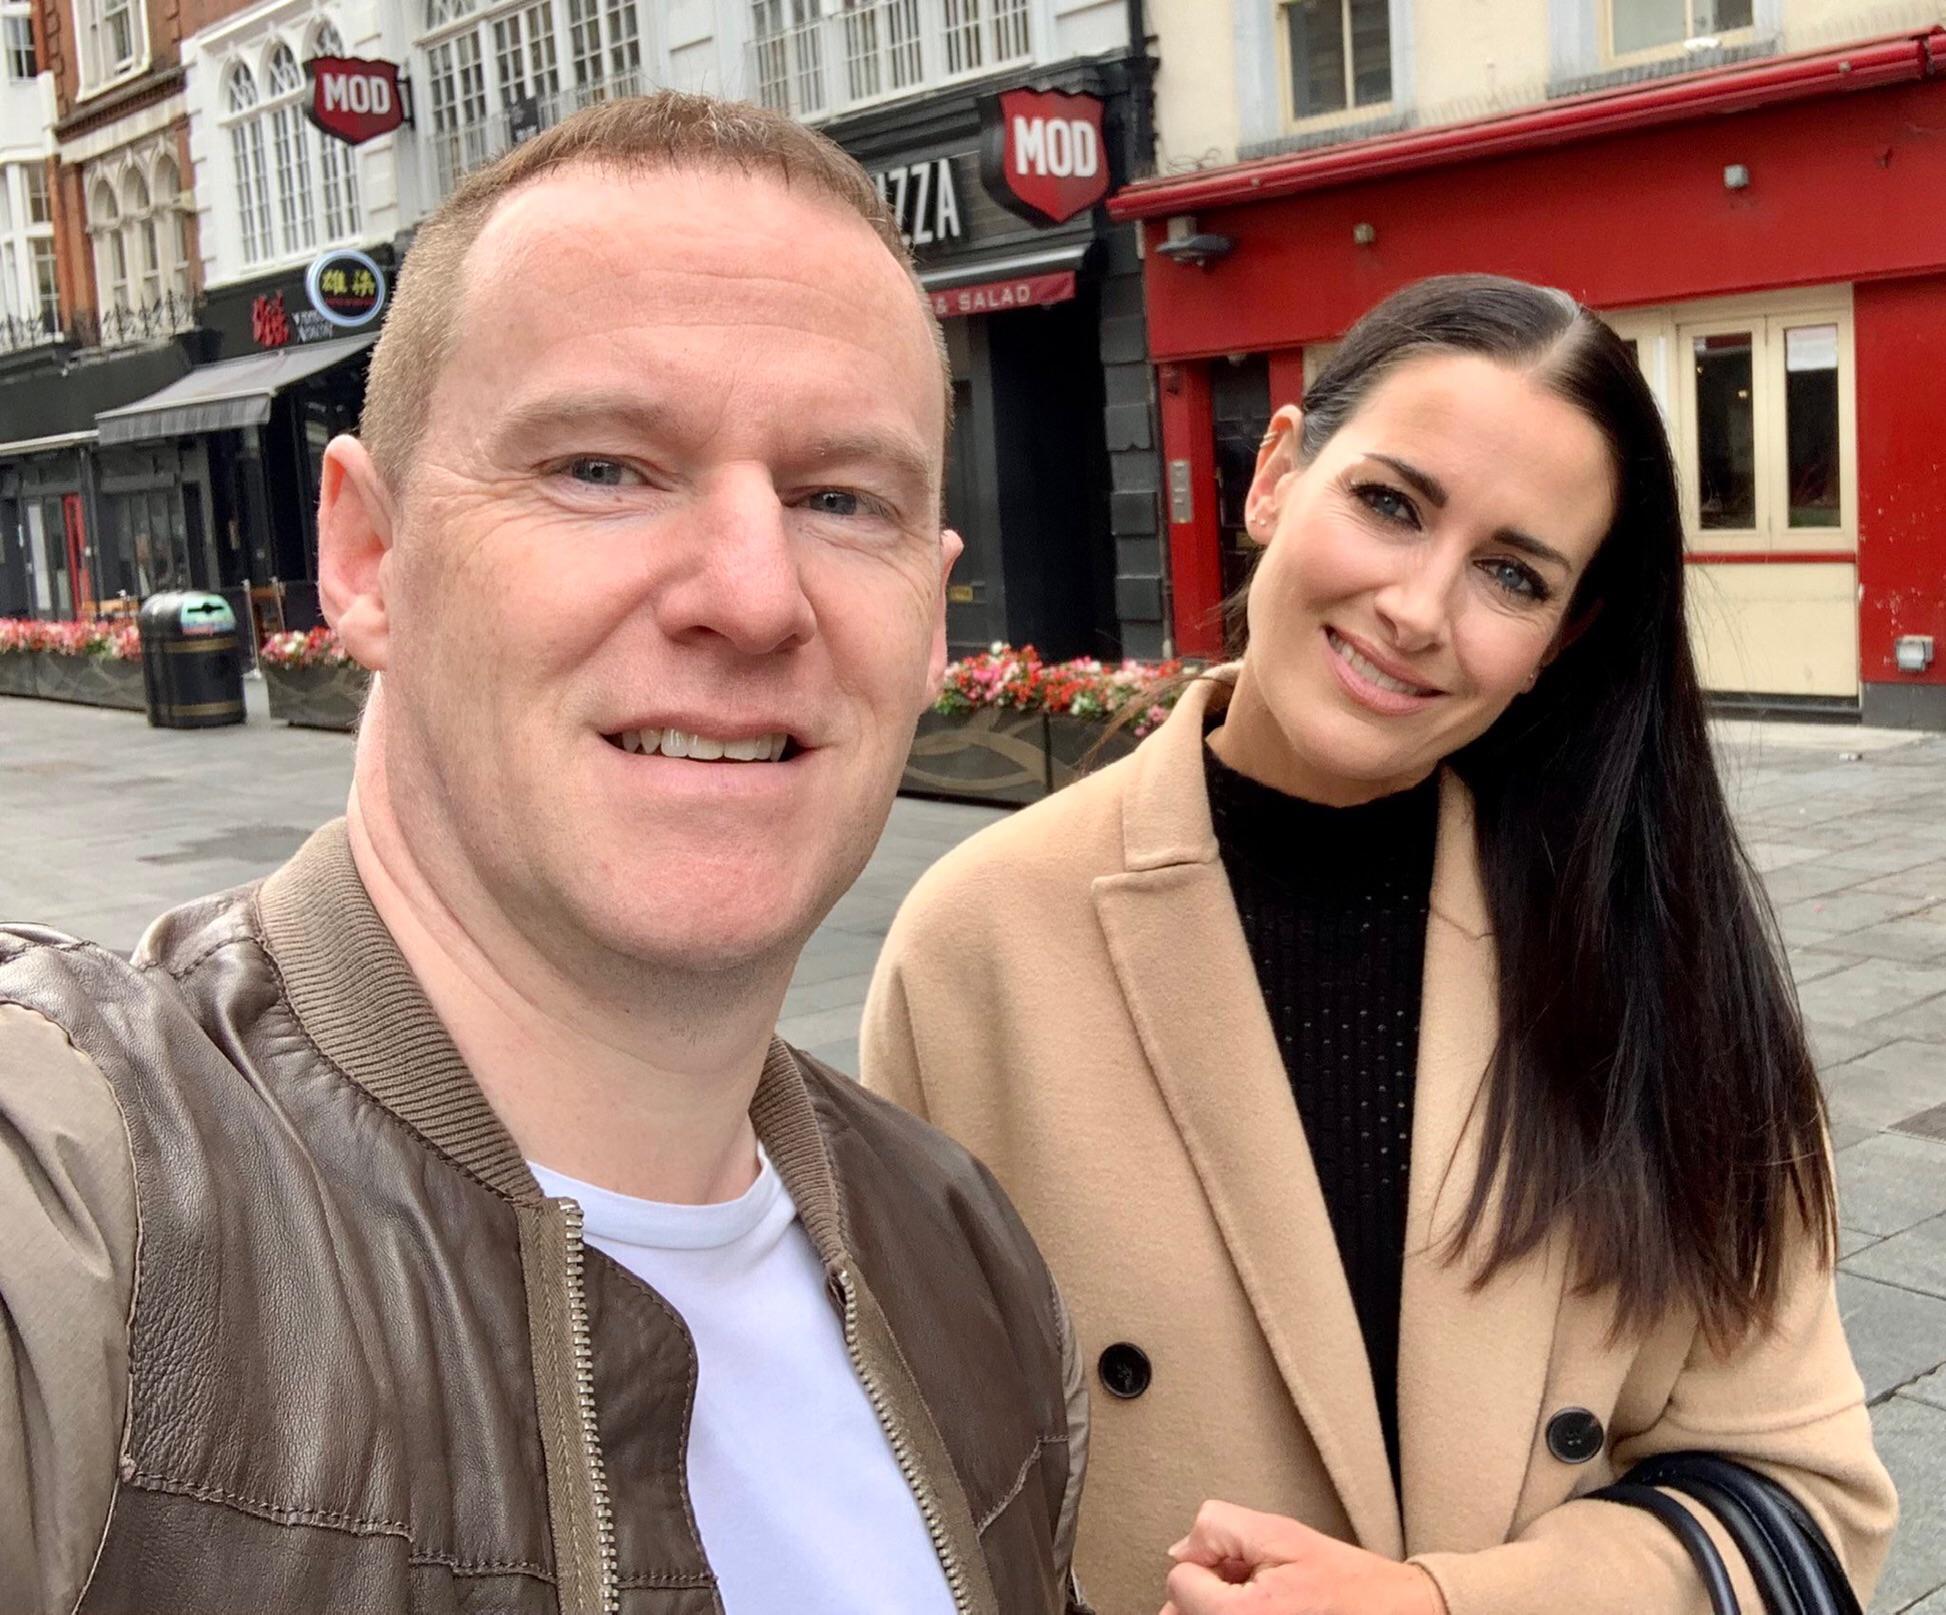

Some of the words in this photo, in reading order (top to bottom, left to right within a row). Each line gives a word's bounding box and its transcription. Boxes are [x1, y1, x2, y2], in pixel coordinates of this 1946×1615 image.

[322, 73, 391, 114] MOD
[1013, 114, 1098, 177] MOD
[958, 285, 1031, 311] SALAD
